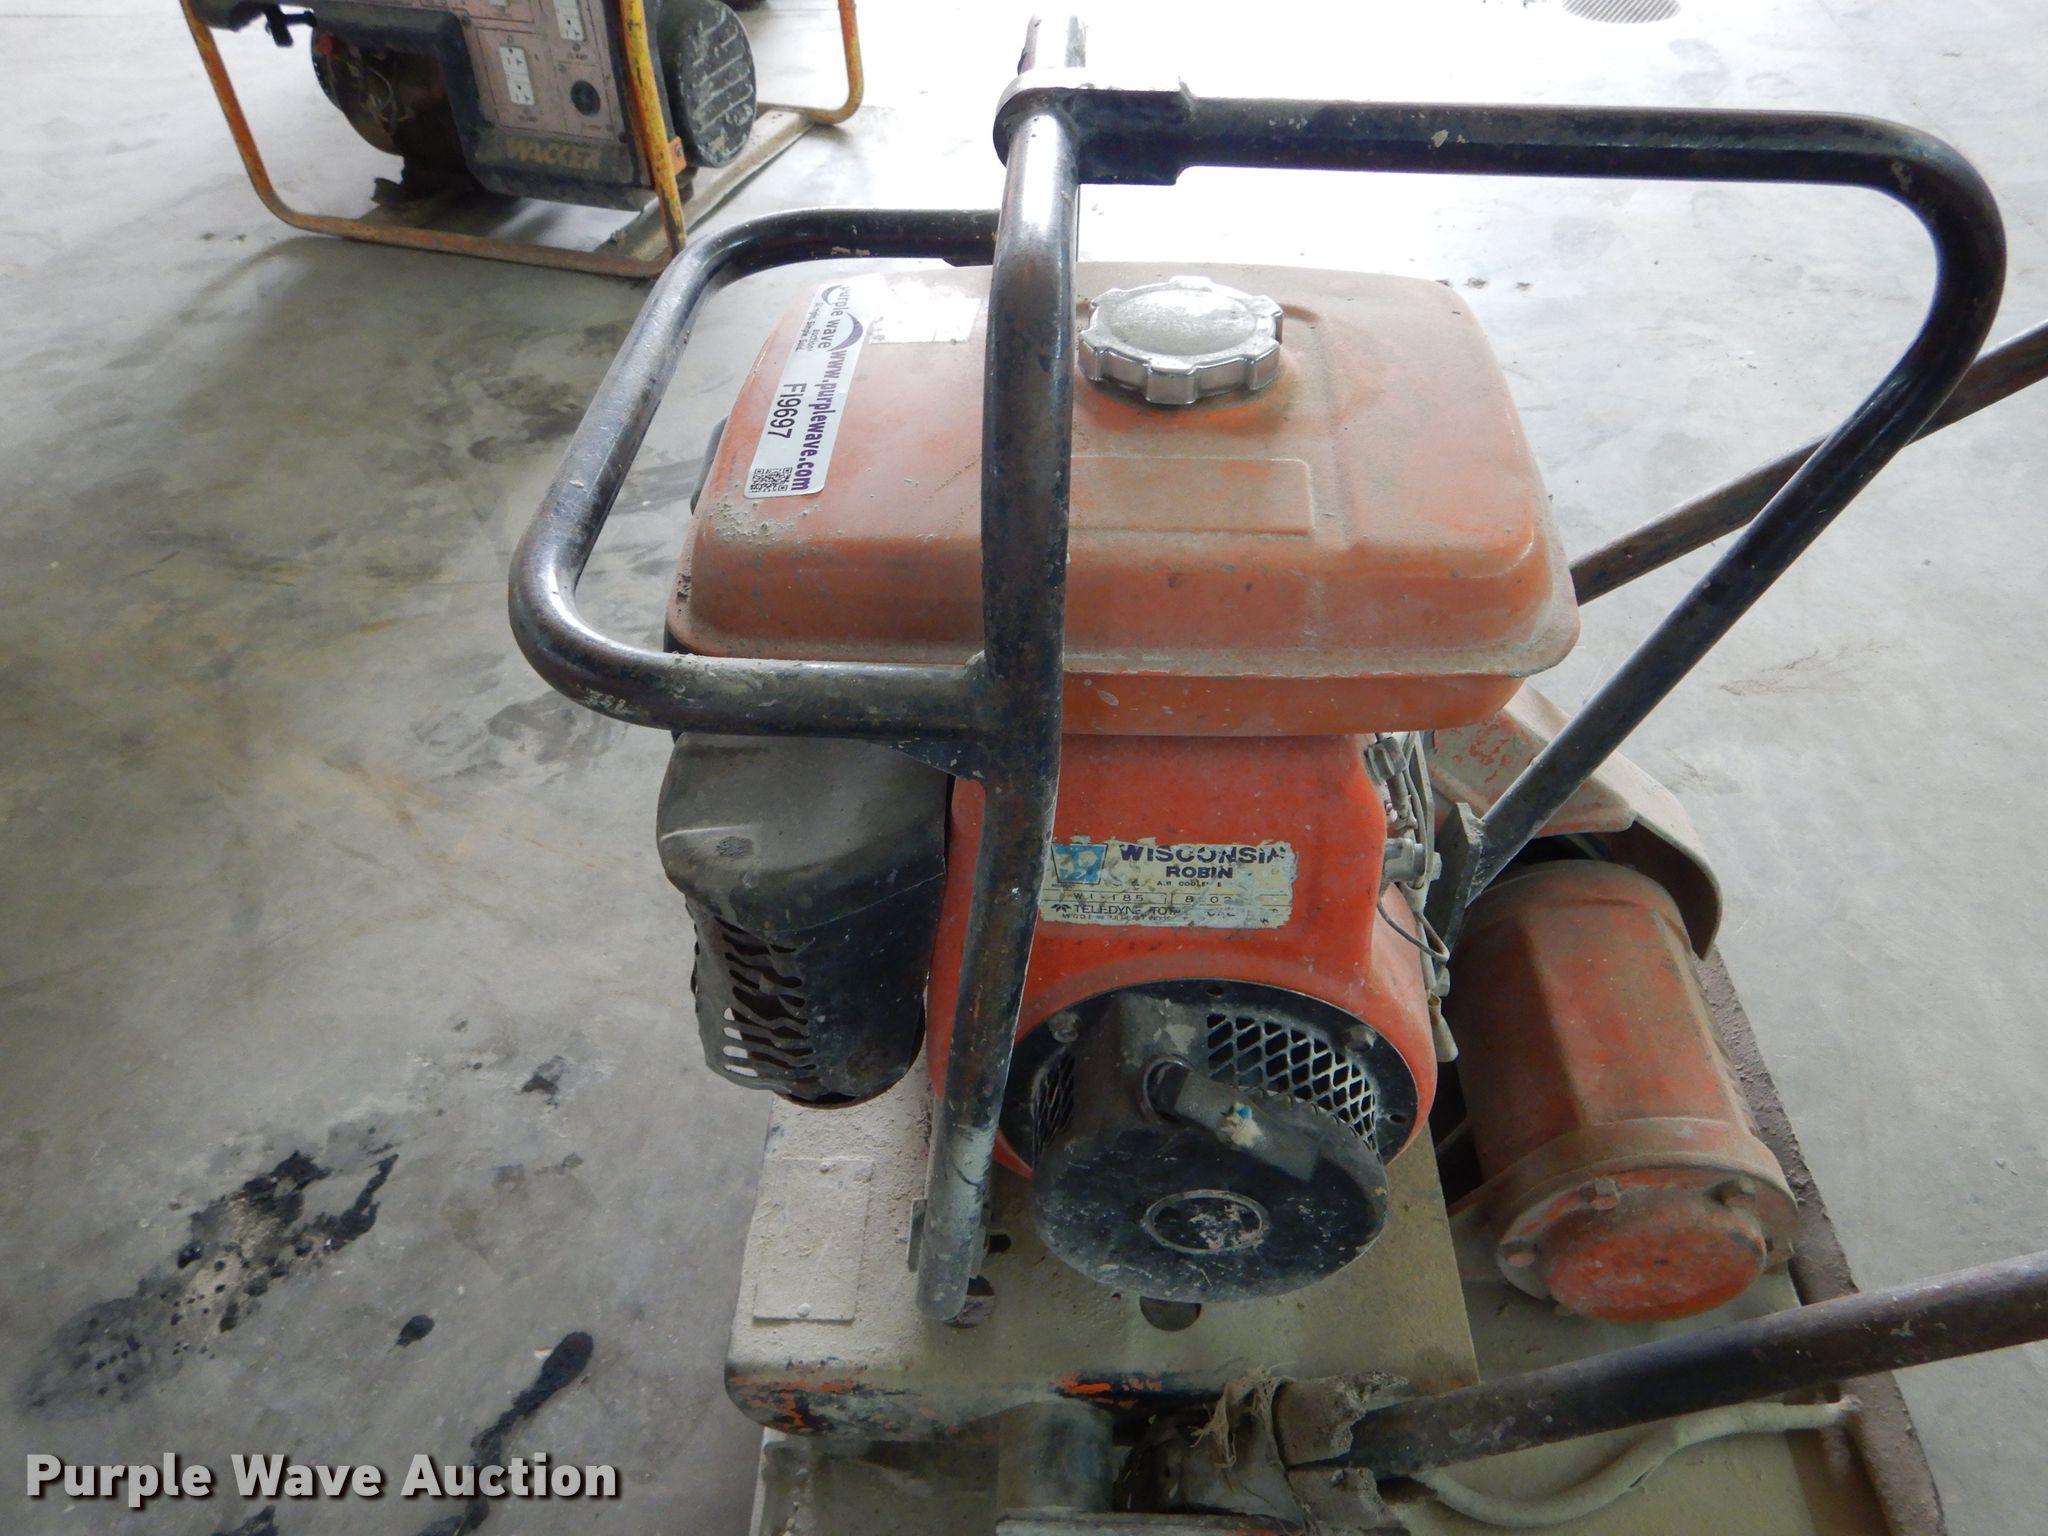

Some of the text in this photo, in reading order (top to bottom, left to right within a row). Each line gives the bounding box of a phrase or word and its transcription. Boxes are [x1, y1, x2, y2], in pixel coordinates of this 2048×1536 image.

[506, 139, 601, 169] WACKER
[818, 319, 840, 349] wave
[767, 383, 807, 440] FI9697
[791, 350, 847, 491] www.purplewave.com
[1165, 866, 1233, 879] ROBIN
